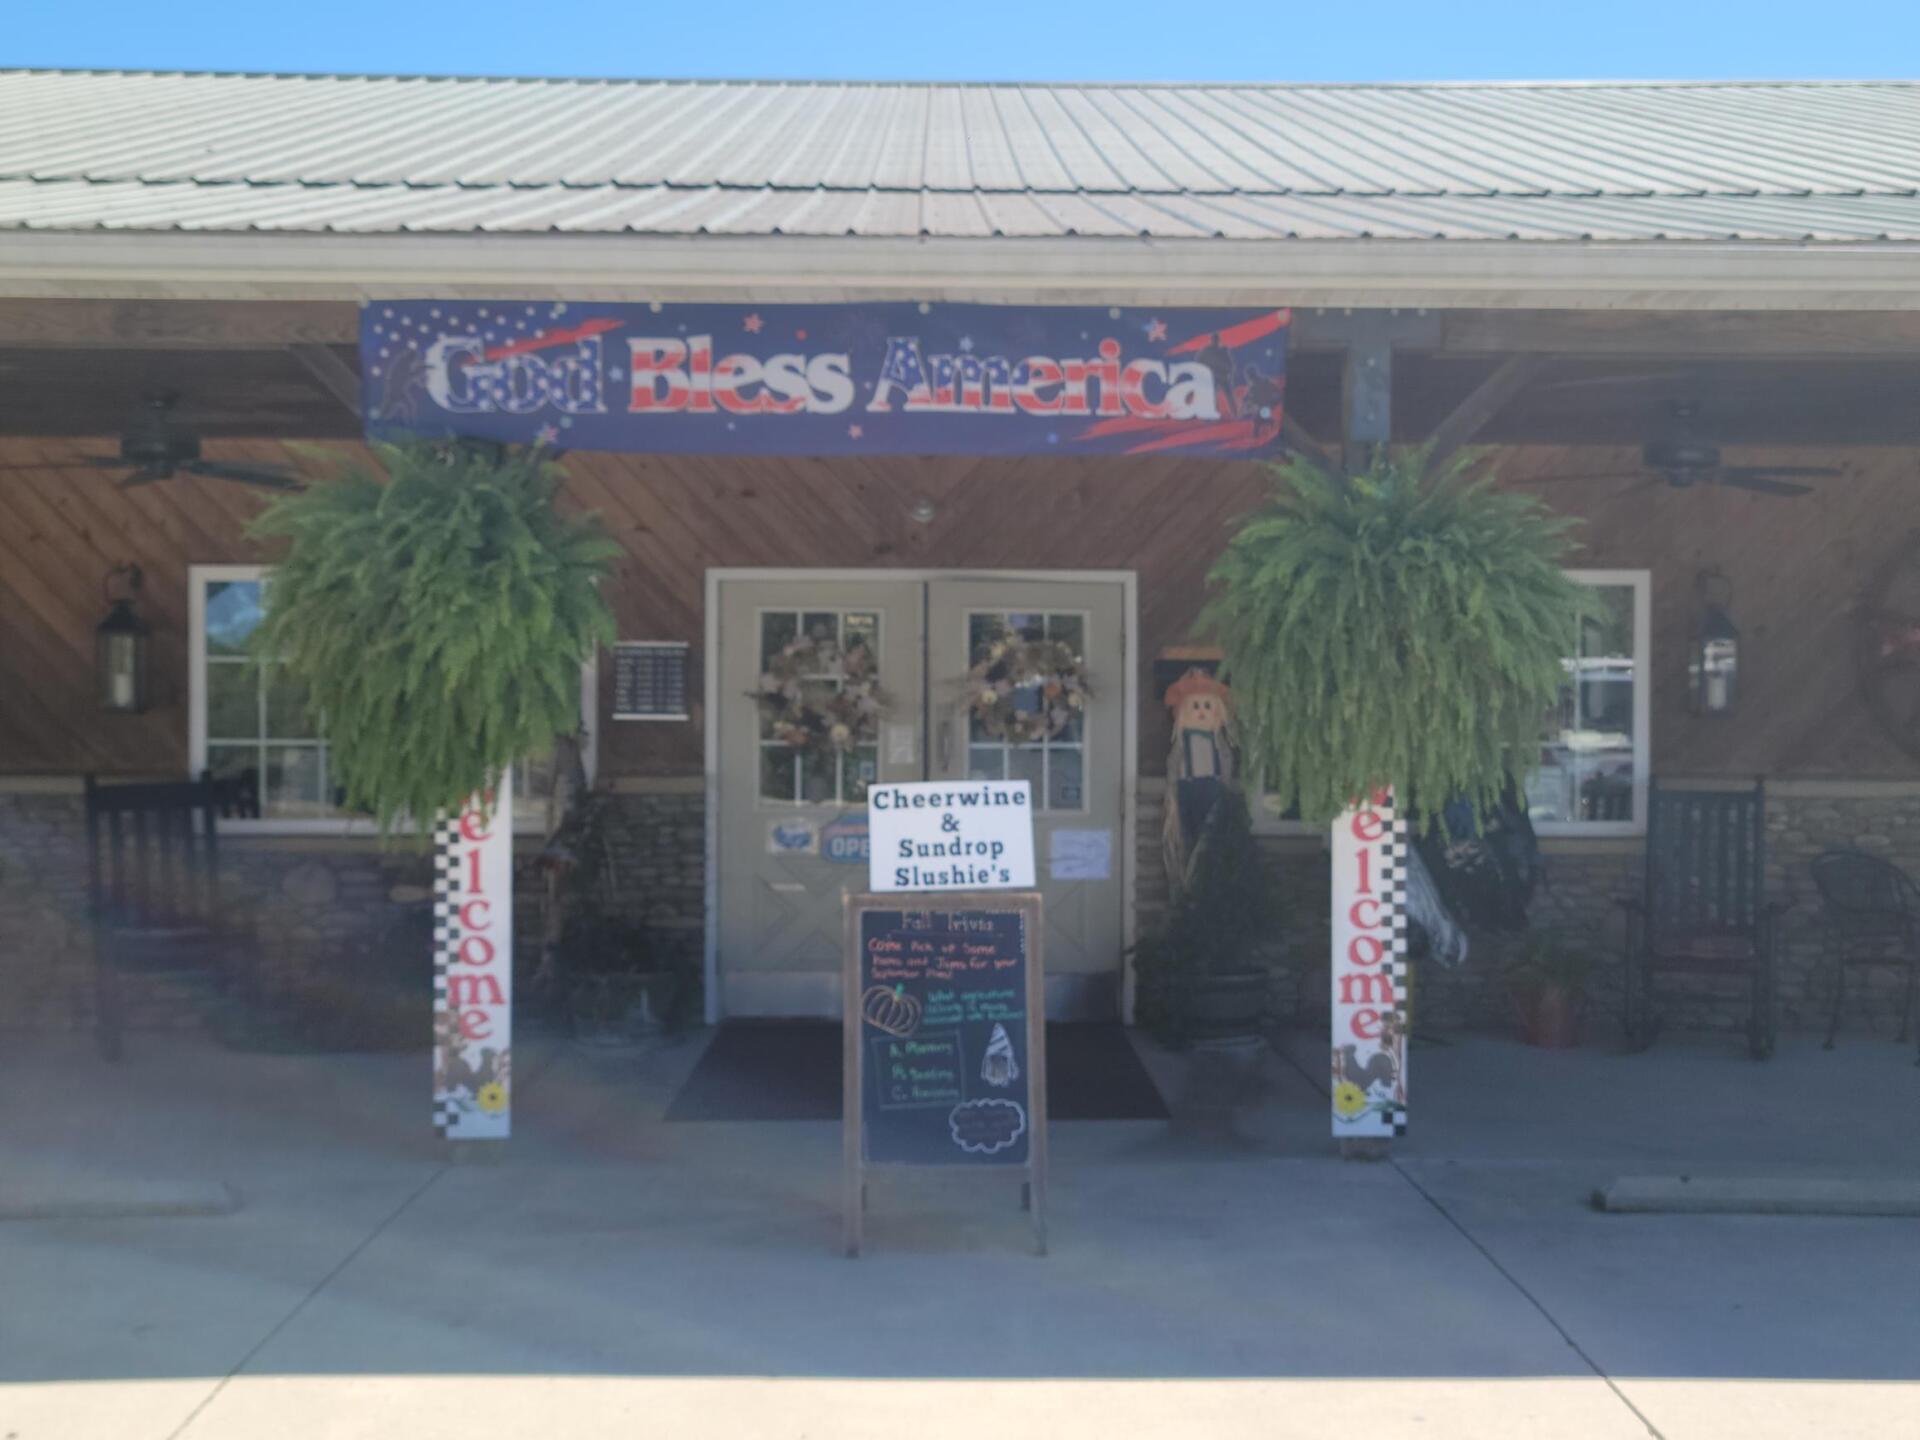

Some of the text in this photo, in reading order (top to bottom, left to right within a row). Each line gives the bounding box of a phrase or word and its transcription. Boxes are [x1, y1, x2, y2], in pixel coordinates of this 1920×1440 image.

[425, 334, 1220, 421] God Bless America
[873, 786, 1026, 810] Cheerwine
[940, 813, 960, 833] &
[831, 837, 869, 857] OPE
[898, 837, 1004, 860] Sundrop
[894, 863, 1011, 887] Slushie's
[446, 786, 506, 1041] elcome
